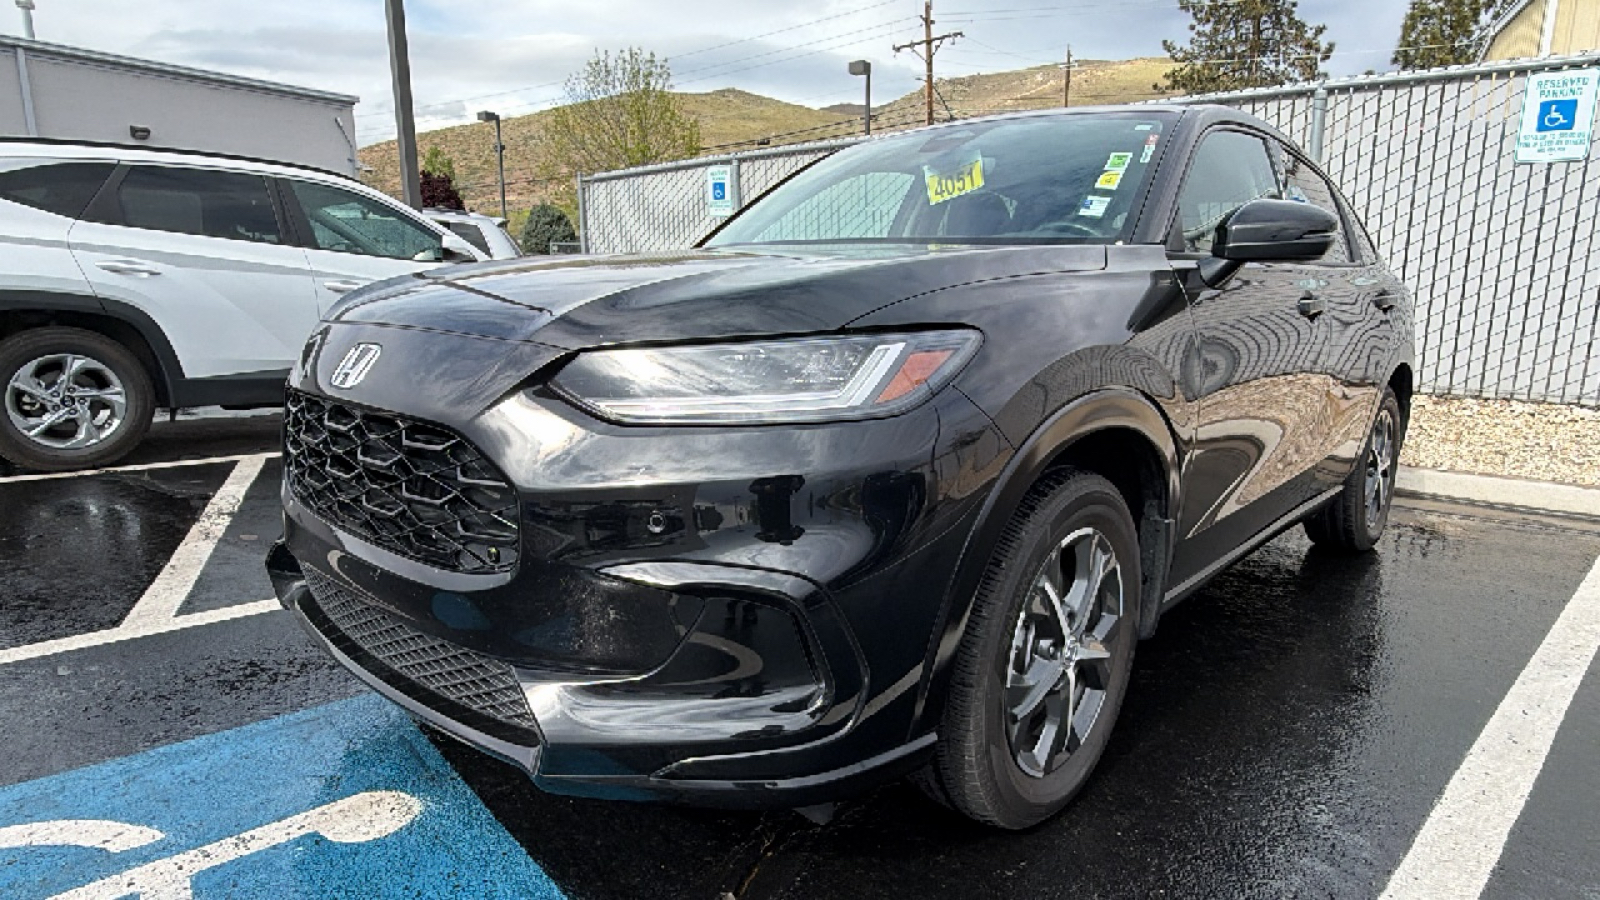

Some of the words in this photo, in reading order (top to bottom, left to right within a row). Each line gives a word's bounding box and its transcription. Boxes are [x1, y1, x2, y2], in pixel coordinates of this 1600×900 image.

[1537, 77, 1589, 89] RESERVED
[1540, 87, 1583, 98] PARKING
[934, 167, 975, 197] 4051
